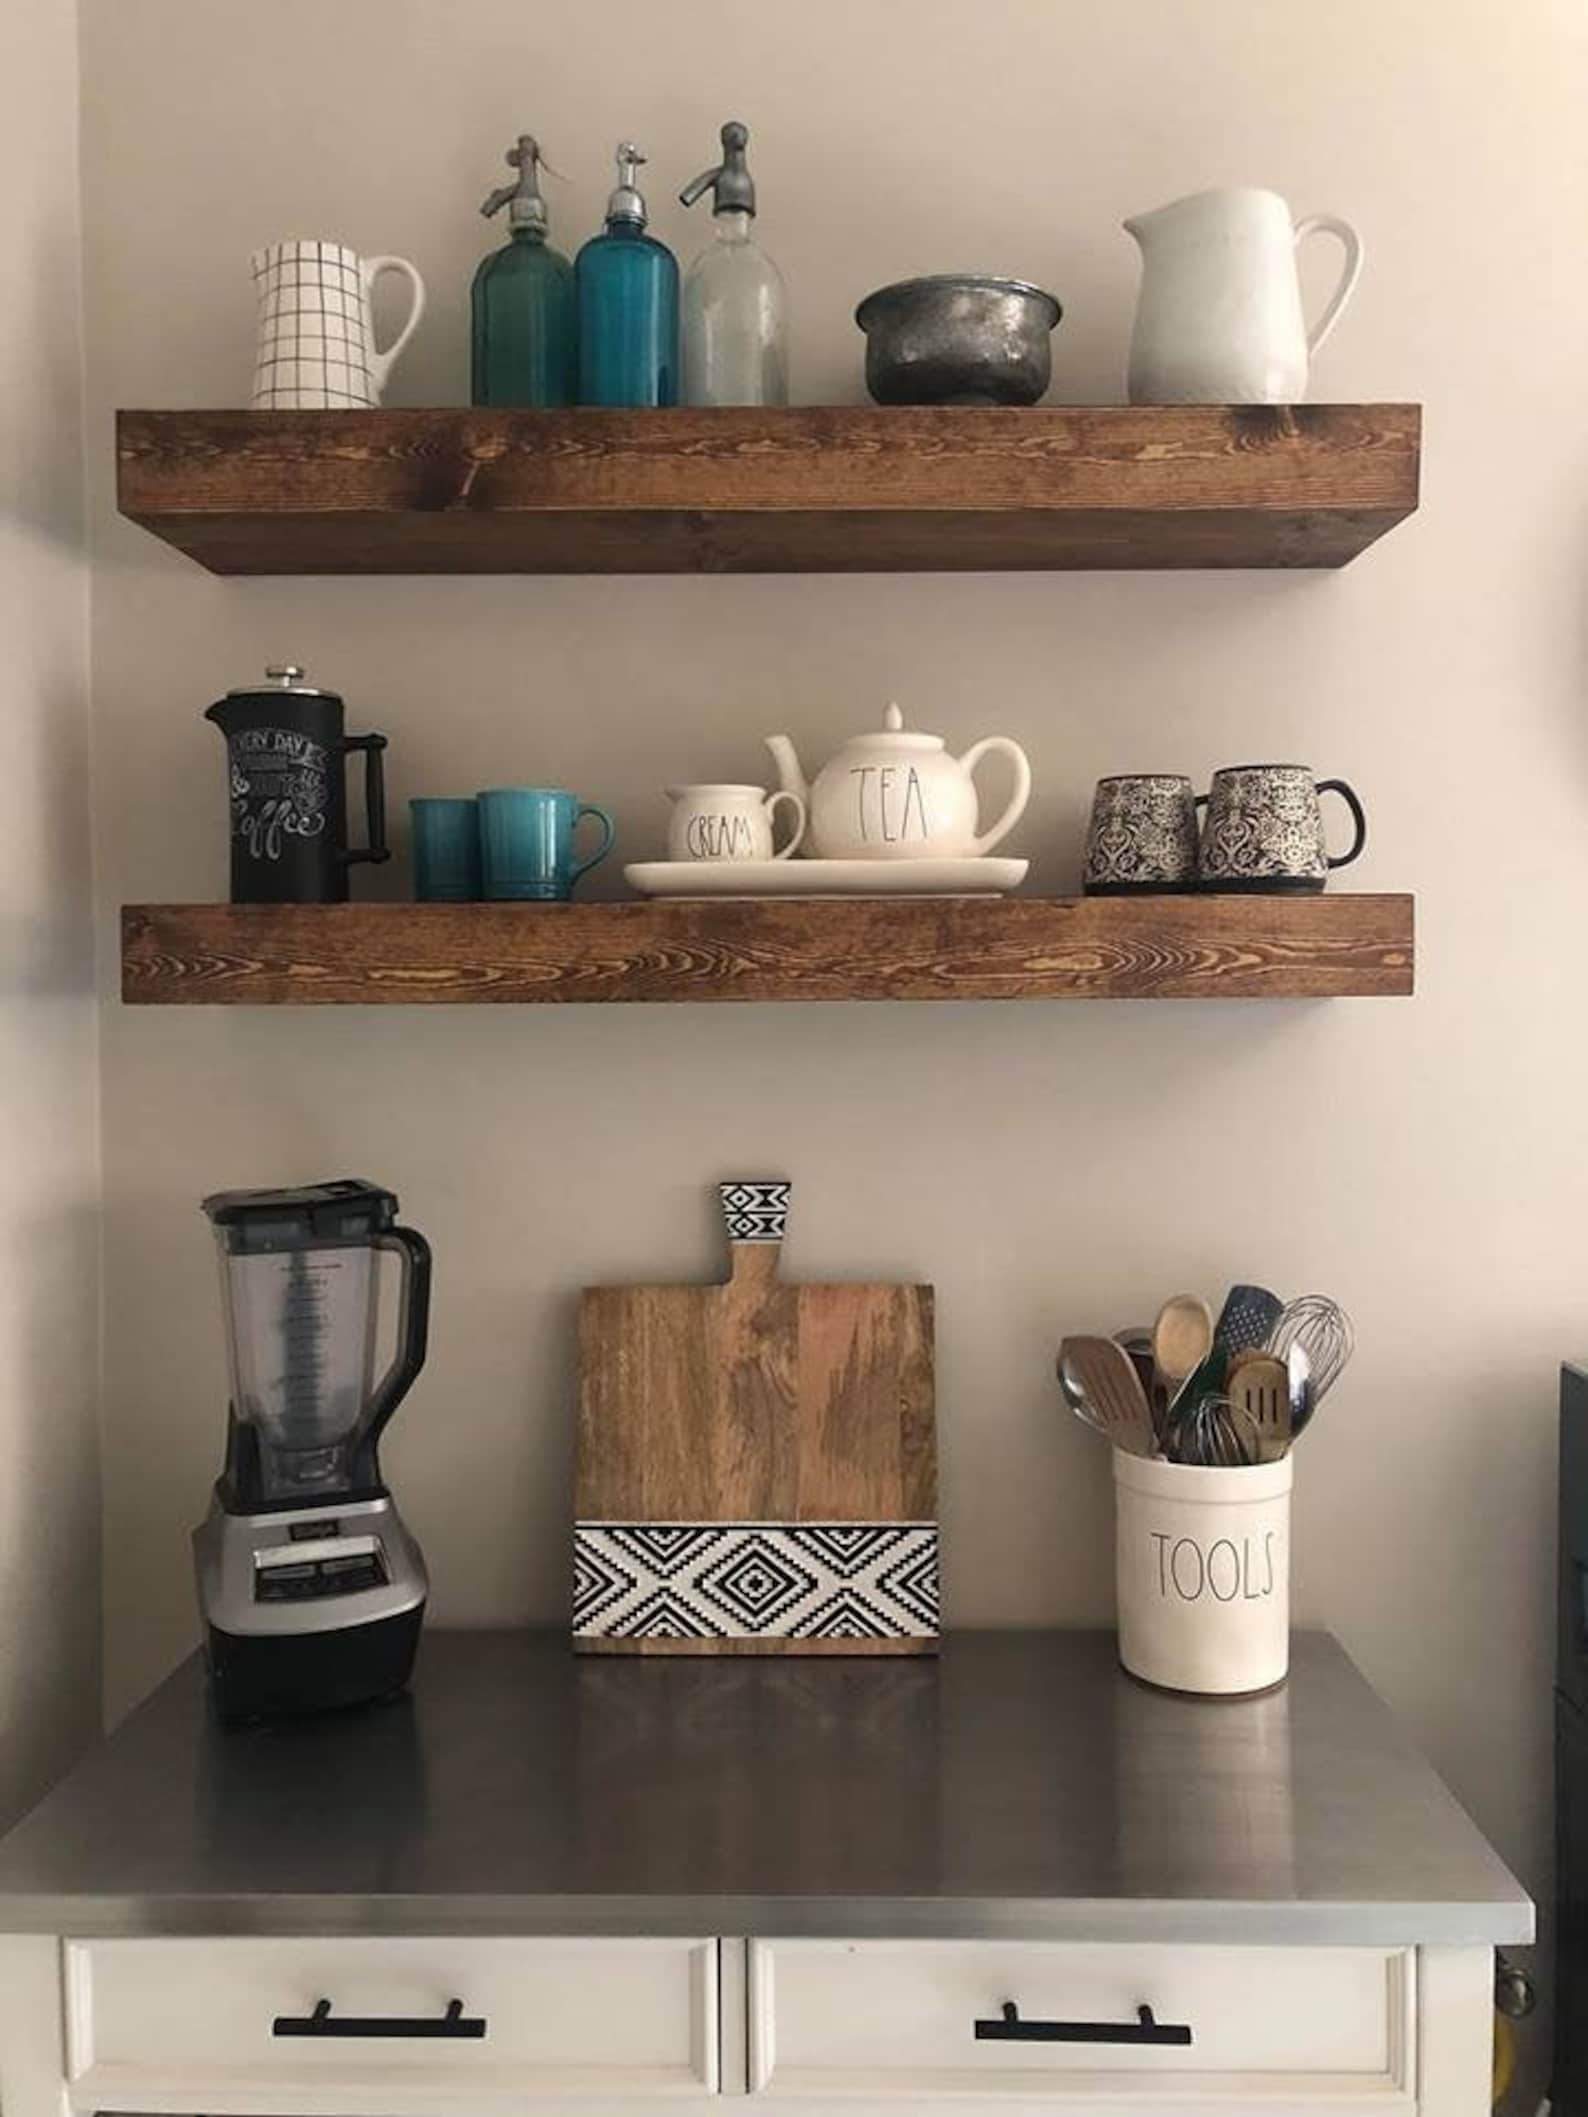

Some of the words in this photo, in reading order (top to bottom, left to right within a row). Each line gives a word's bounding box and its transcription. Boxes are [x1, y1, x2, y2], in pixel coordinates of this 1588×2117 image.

[687, 814, 753, 858] CREAM
[850, 767, 927, 842] TEA
[1150, 1531, 1274, 1601] TOOLS
